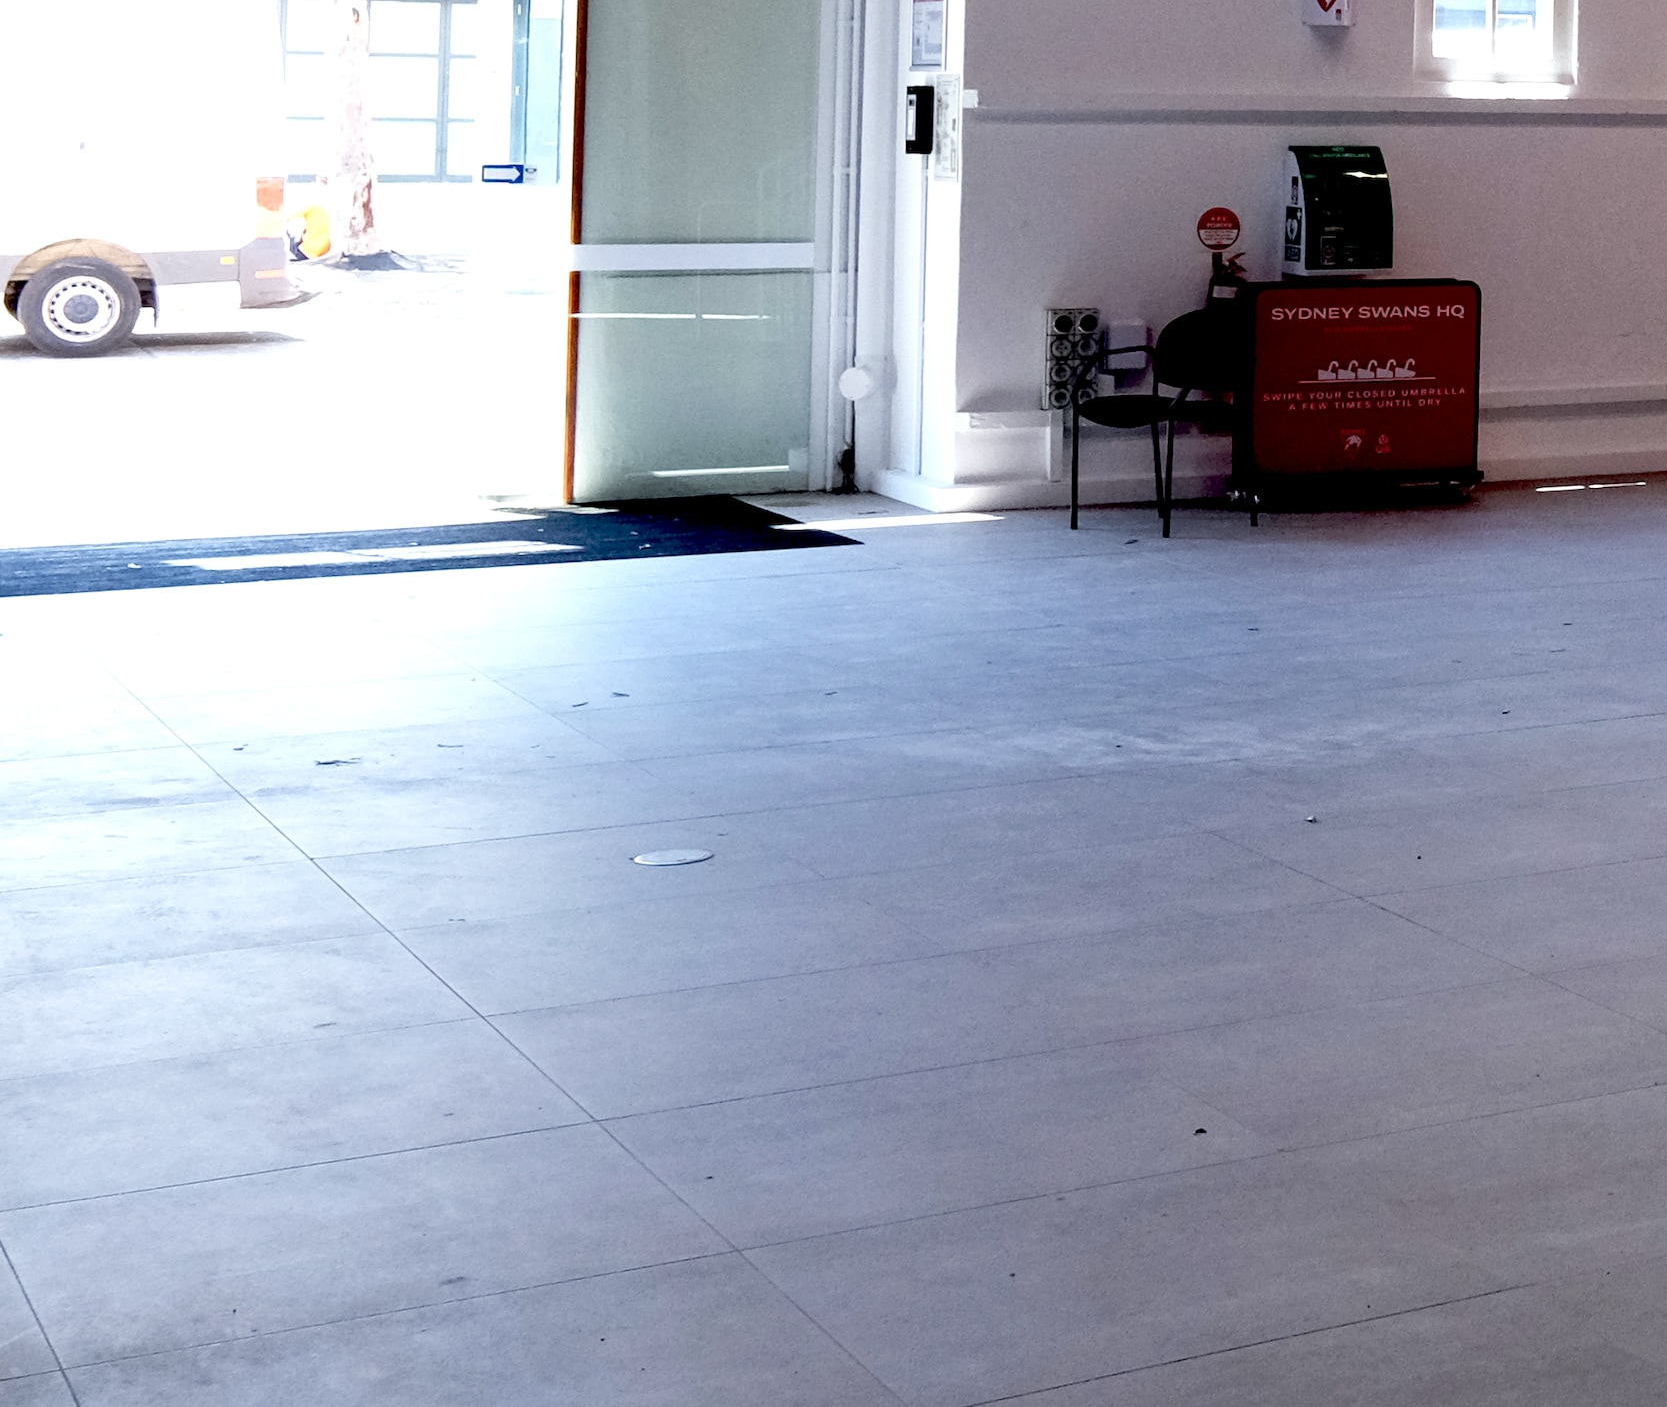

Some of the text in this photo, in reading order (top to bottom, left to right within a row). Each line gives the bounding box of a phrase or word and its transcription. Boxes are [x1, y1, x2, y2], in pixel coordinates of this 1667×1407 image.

[1271, 304, 1466, 321] SYDNEY SWANS HQ
[1263, 387, 1466, 402] SWIPE YOUR CLOSED UMBRELLA
[1302, 402, 1328, 410] FEW
[1334, 401, 1371, 409] TIMES
[1377, 400, 1413, 408] UNTIL
[1418, 399, 1442, 407] DRY
